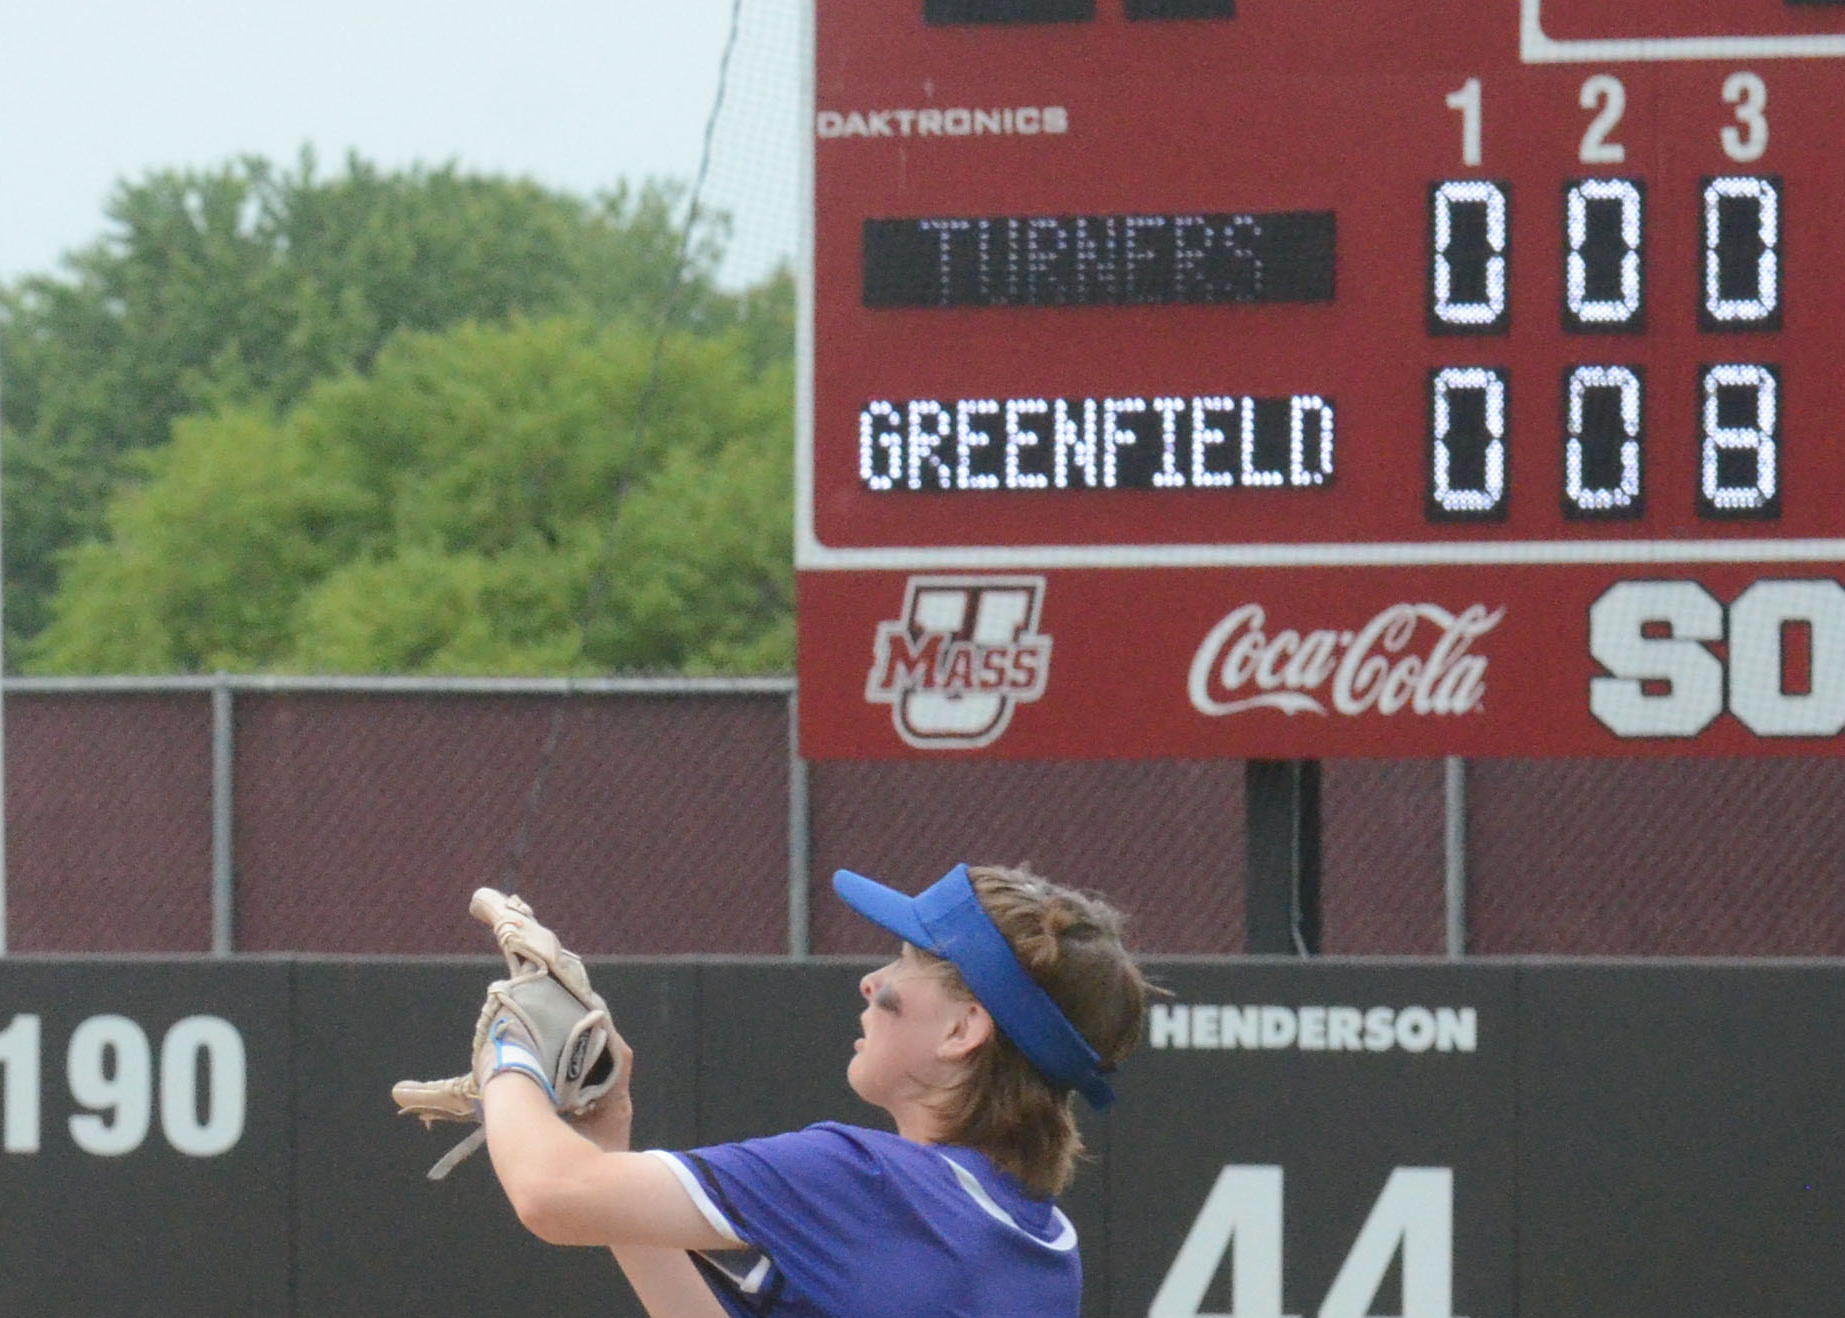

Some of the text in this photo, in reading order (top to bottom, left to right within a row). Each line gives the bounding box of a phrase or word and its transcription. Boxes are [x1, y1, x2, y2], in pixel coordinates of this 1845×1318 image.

[816, 106, 1069, 138] DAKTRONICS
[1445, 71, 1769, 167] 1 2 3
[919, 216, 1262, 304] TURNERS
[1434, 177, 1777, 324] 0 0 0
[858, 395, 1333, 491] GREENFIELD
[1434, 365, 1776, 510] 0 0 8
[1188, 604, 1505, 716] Coca-Cola
[1149, 1004, 1478, 1052] HENDERSON
